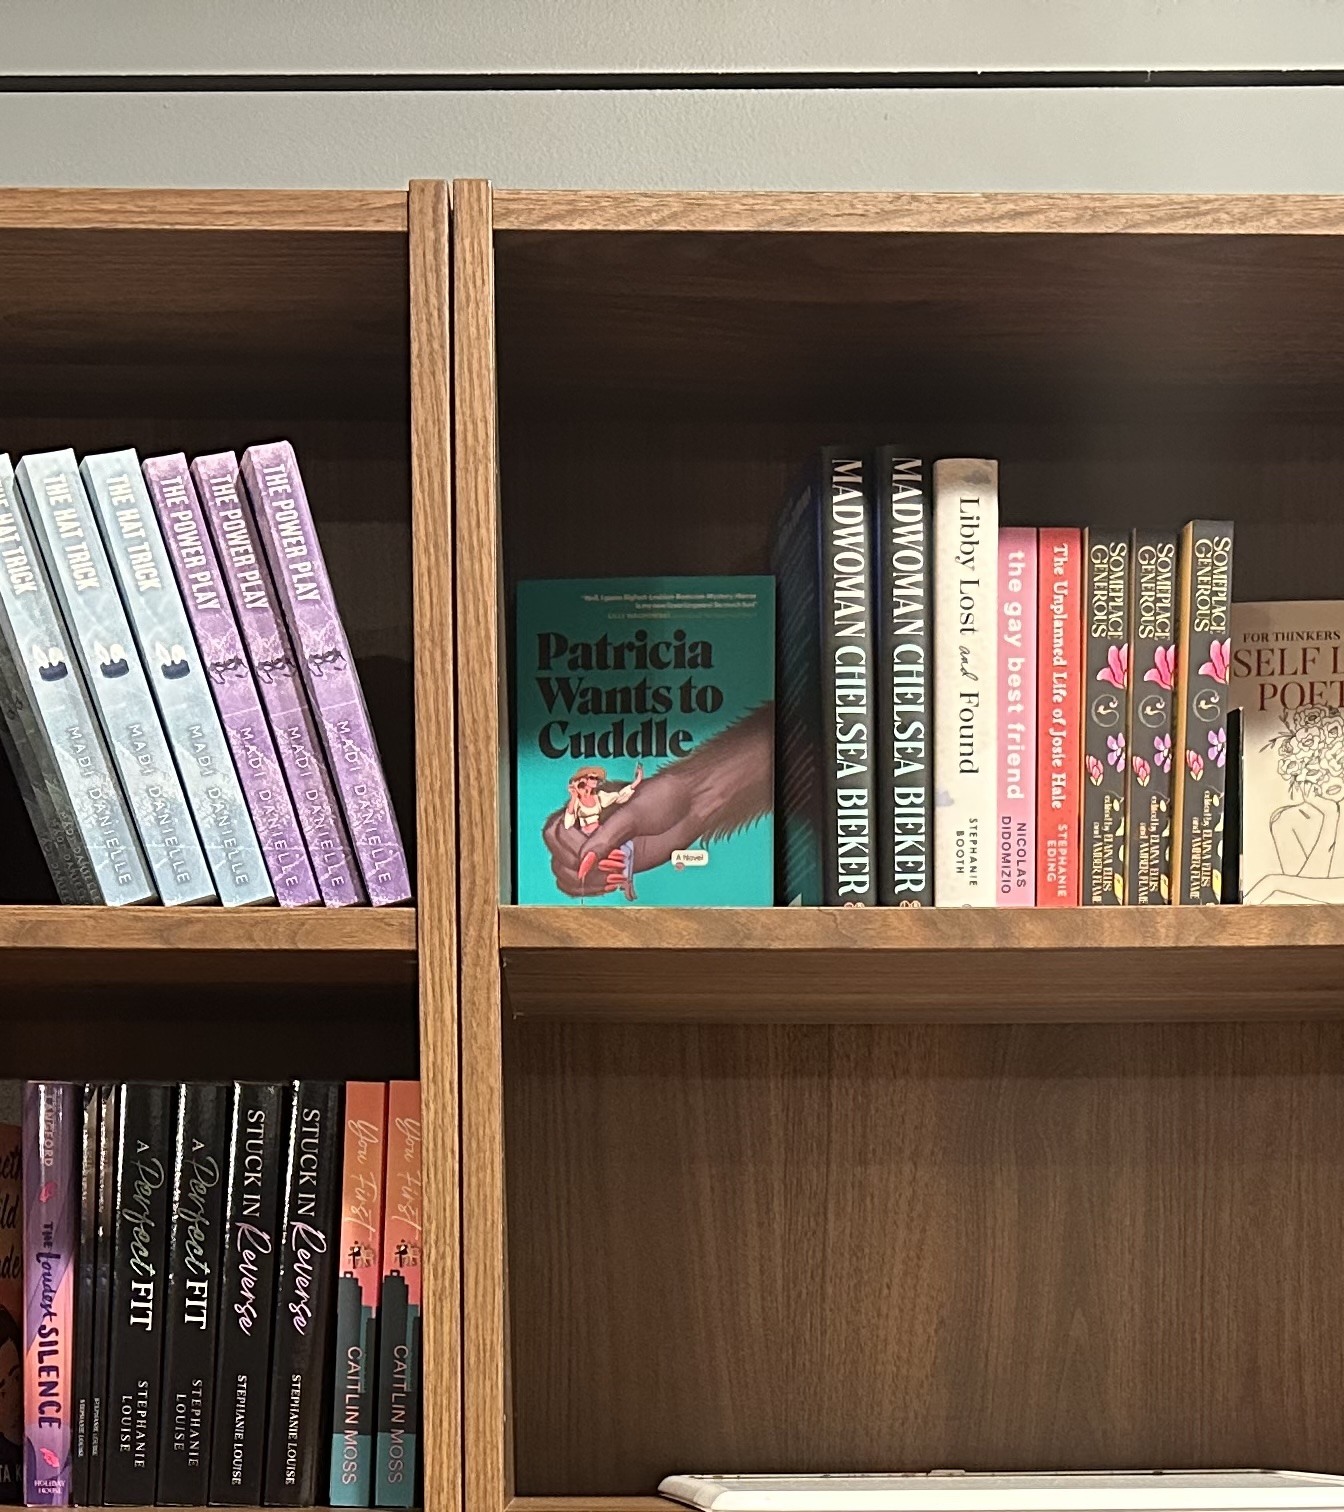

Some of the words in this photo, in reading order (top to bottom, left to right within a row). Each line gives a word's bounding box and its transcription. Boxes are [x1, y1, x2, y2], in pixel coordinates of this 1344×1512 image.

[263, 464, 291, 496] THE
[272, 499, 307, 558] POWER
[831, 459, 866, 639] MADWOMAN
[2, 546, 37, 595] TRICK
[289, 561, 320, 600] PLAY
[1006, 549, 1023, 593] the
[536, 629, 714, 670] Patricia
[1003, 599, 1023, 647] gay
[1243, 632, 1269, 643] FOR
[1272, 630, 1340, 642] THINKERS
[1007, 657, 1024, 716] best
[1233, 647, 1320, 678] SELF
[536, 676, 672, 714] Wants
[679, 676, 724, 713] to
[833, 644, 868, 779] CHELSEA
[538, 718, 693, 759] Cuddle
[1006, 717, 1025, 800] friend
[337, 721, 361, 771] MADI
[354, 785, 391, 883] DANIELLE
[683, 853, 704, 861] Novel
[837, 787, 870, 896] BIEKER
[1001, 816, 1011, 894] DIDOMIZIO
[1016, 822, 1026, 888] NICOLAS
[244, 1109, 266, 1189] STUCK
[243, 1193, 261, 1217] IN
[235, 1221, 272, 1337] Reverse
[345, 1346, 363, 1425] CAITLIN
[342, 1428, 360, 1486] MOSS
